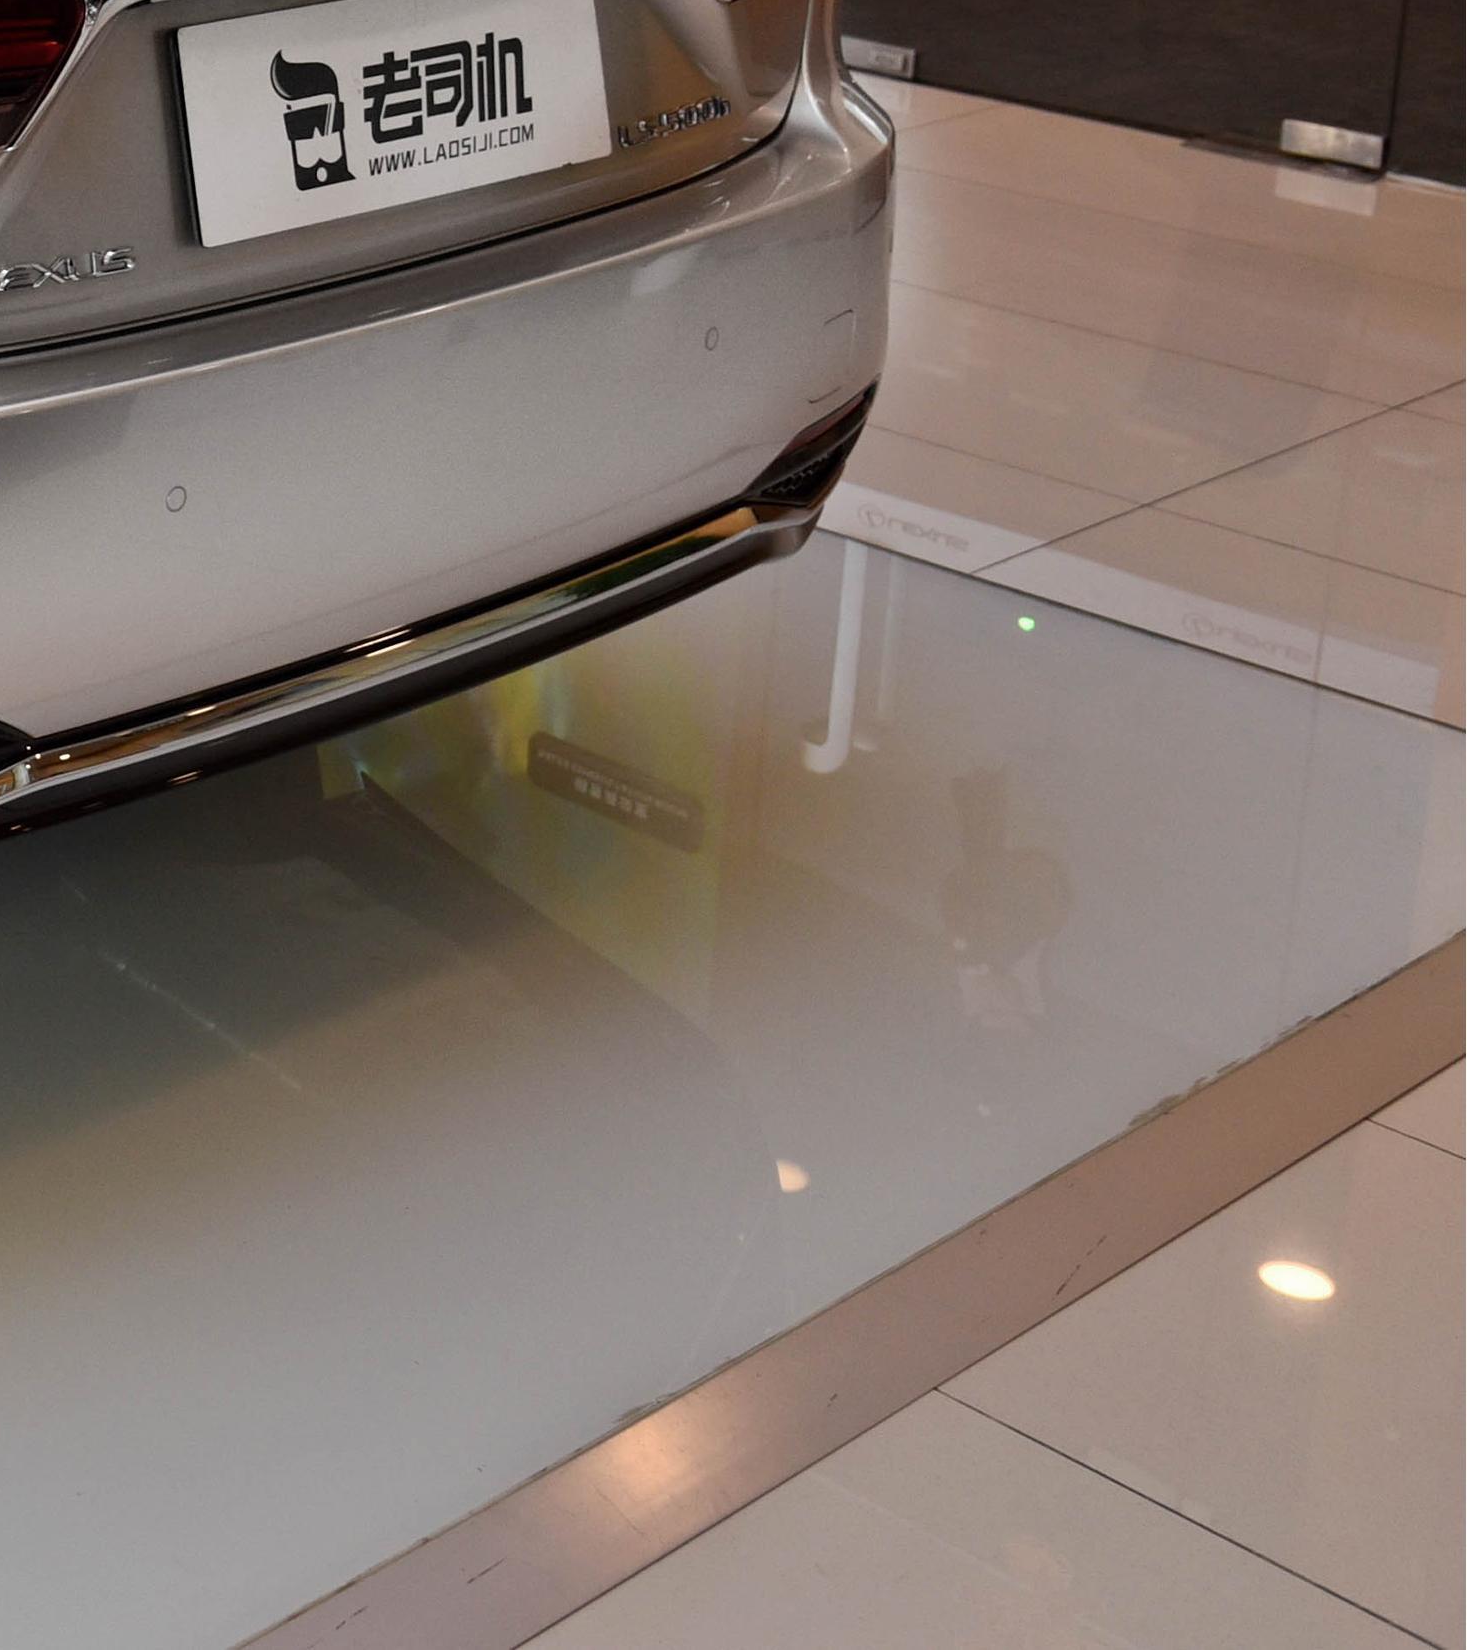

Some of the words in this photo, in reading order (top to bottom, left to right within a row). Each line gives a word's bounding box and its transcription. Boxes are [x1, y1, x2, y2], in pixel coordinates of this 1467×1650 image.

[362, 32, 534, 145] 老司机
[368, 122, 535, 177] WWW.LAOSIJI.COM
